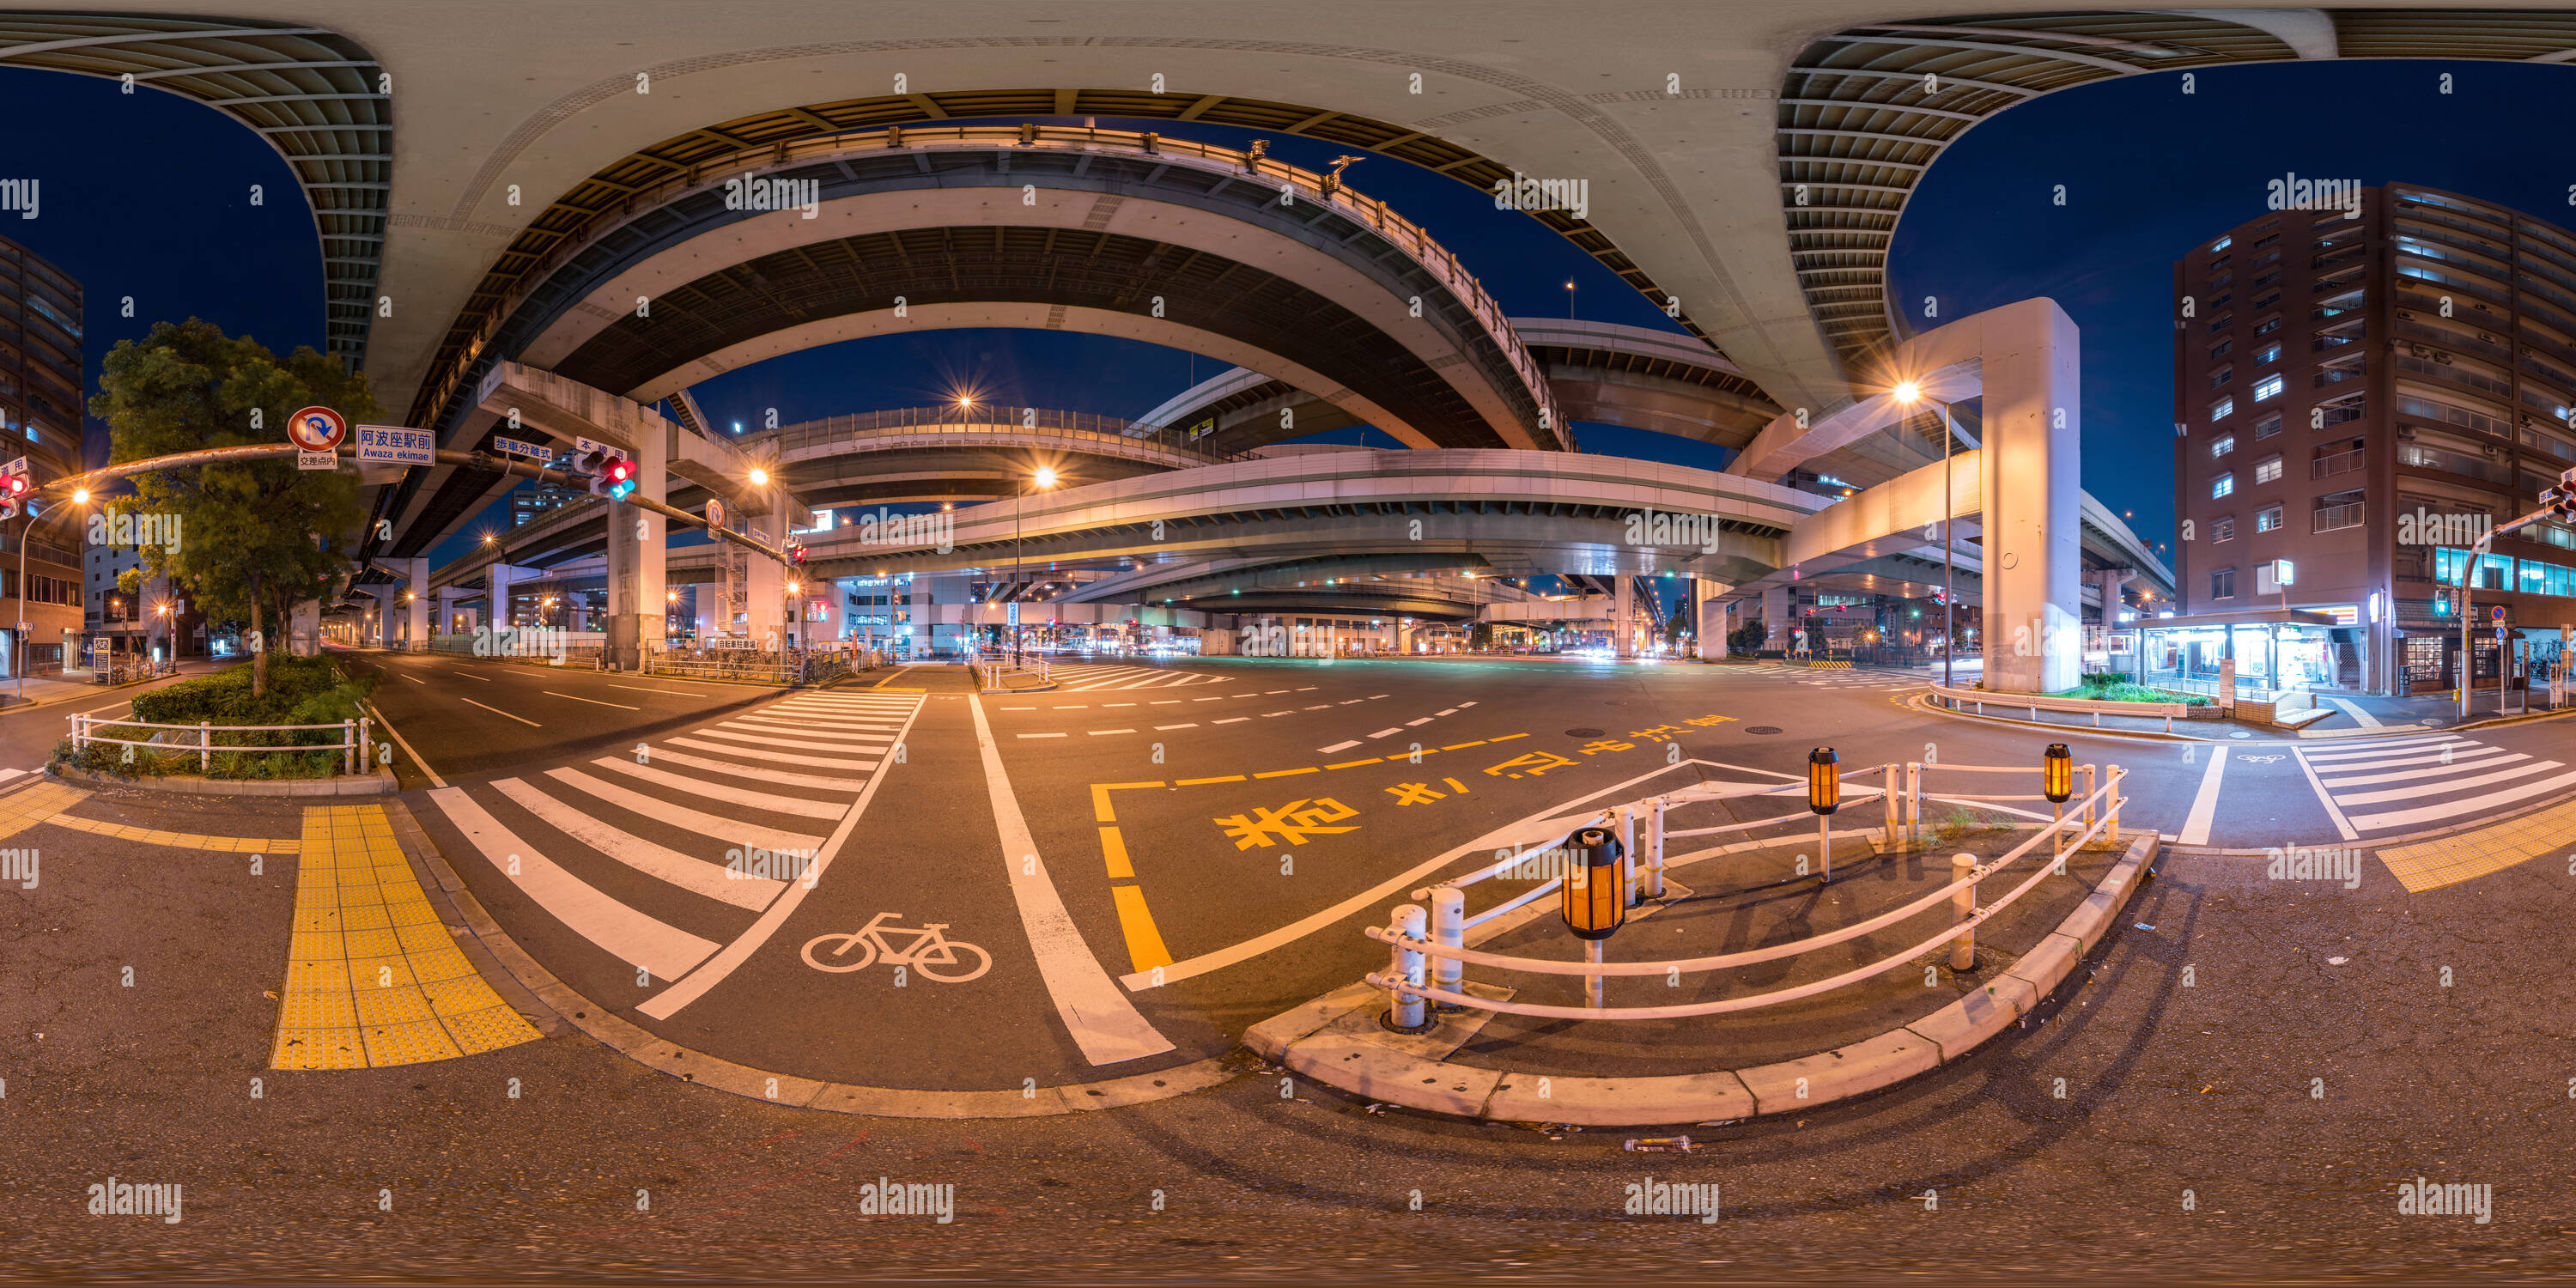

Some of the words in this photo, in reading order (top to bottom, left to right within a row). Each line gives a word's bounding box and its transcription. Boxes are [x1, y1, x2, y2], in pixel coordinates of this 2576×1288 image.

[361, 429, 431, 450] 阿波座駅前
[496, 439, 550, 460] 歩車分離式
[580, 439, 623, 461] 本線用
[301, 457, 336, 466] 交差点内
[363, 448, 393, 459] Awaza
[397, 452, 429, 461] ekimae
[1212, 714, 1741, 851] 巻き込み注意
